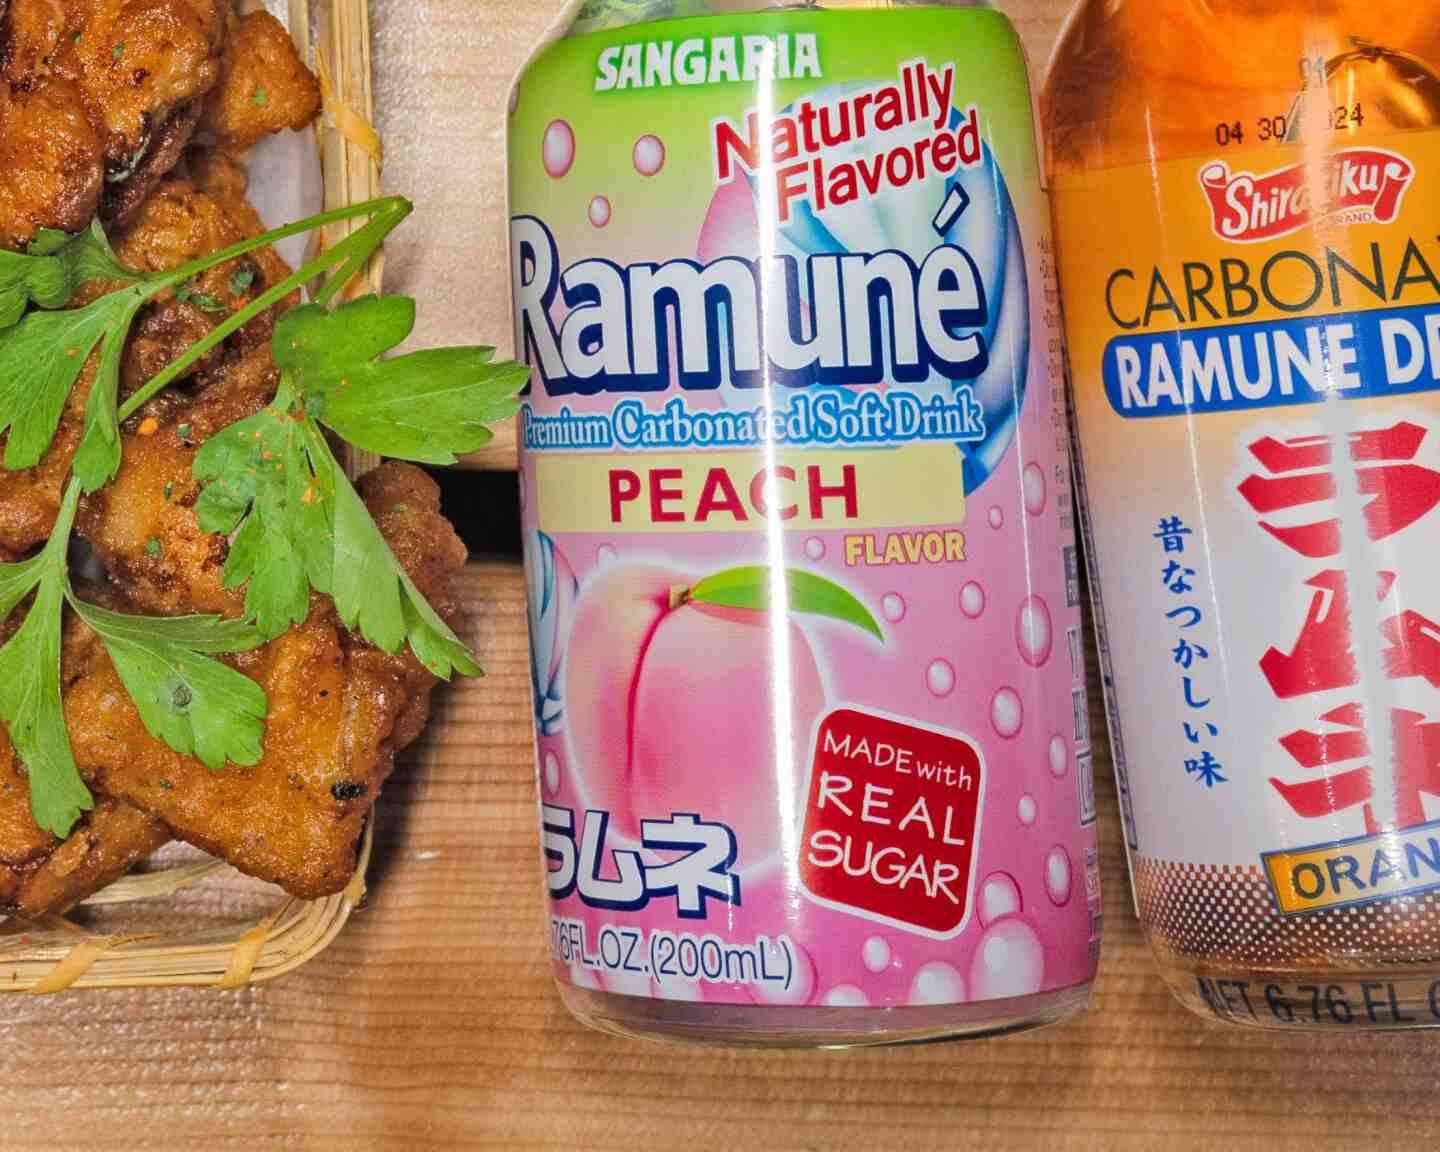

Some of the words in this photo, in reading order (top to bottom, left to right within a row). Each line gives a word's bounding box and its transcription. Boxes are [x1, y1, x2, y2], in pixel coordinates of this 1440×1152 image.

[595, 34, 822, 91] SANGARIA
[714, 62, 954, 180] Naturally
[1216, 122, 1243, 146] 04
[1257, 115, 1286, 141] 30
[775, 110, 981, 223] Flavored
[1106, 235, 1440, 330] CARBONA
[1115, 323, 1360, 408] RAMUNE
[613, 398, 815, 448] Carbonated
[815, 394, 889, 443] Soft
[892, 388, 984, 442] Drink
[608, 463, 858, 523] PEACH
[845, 530, 966, 567] FLAVOR
[1152, 515, 1228, 788] 昔なつかしい味
[823, 729, 913, 773] MADE
[916, 761, 972, 791] with
[817, 770, 966, 846] REAL
[807, 830, 959, 905] SUGAR
[1361, 982, 1417, 1023] FL
